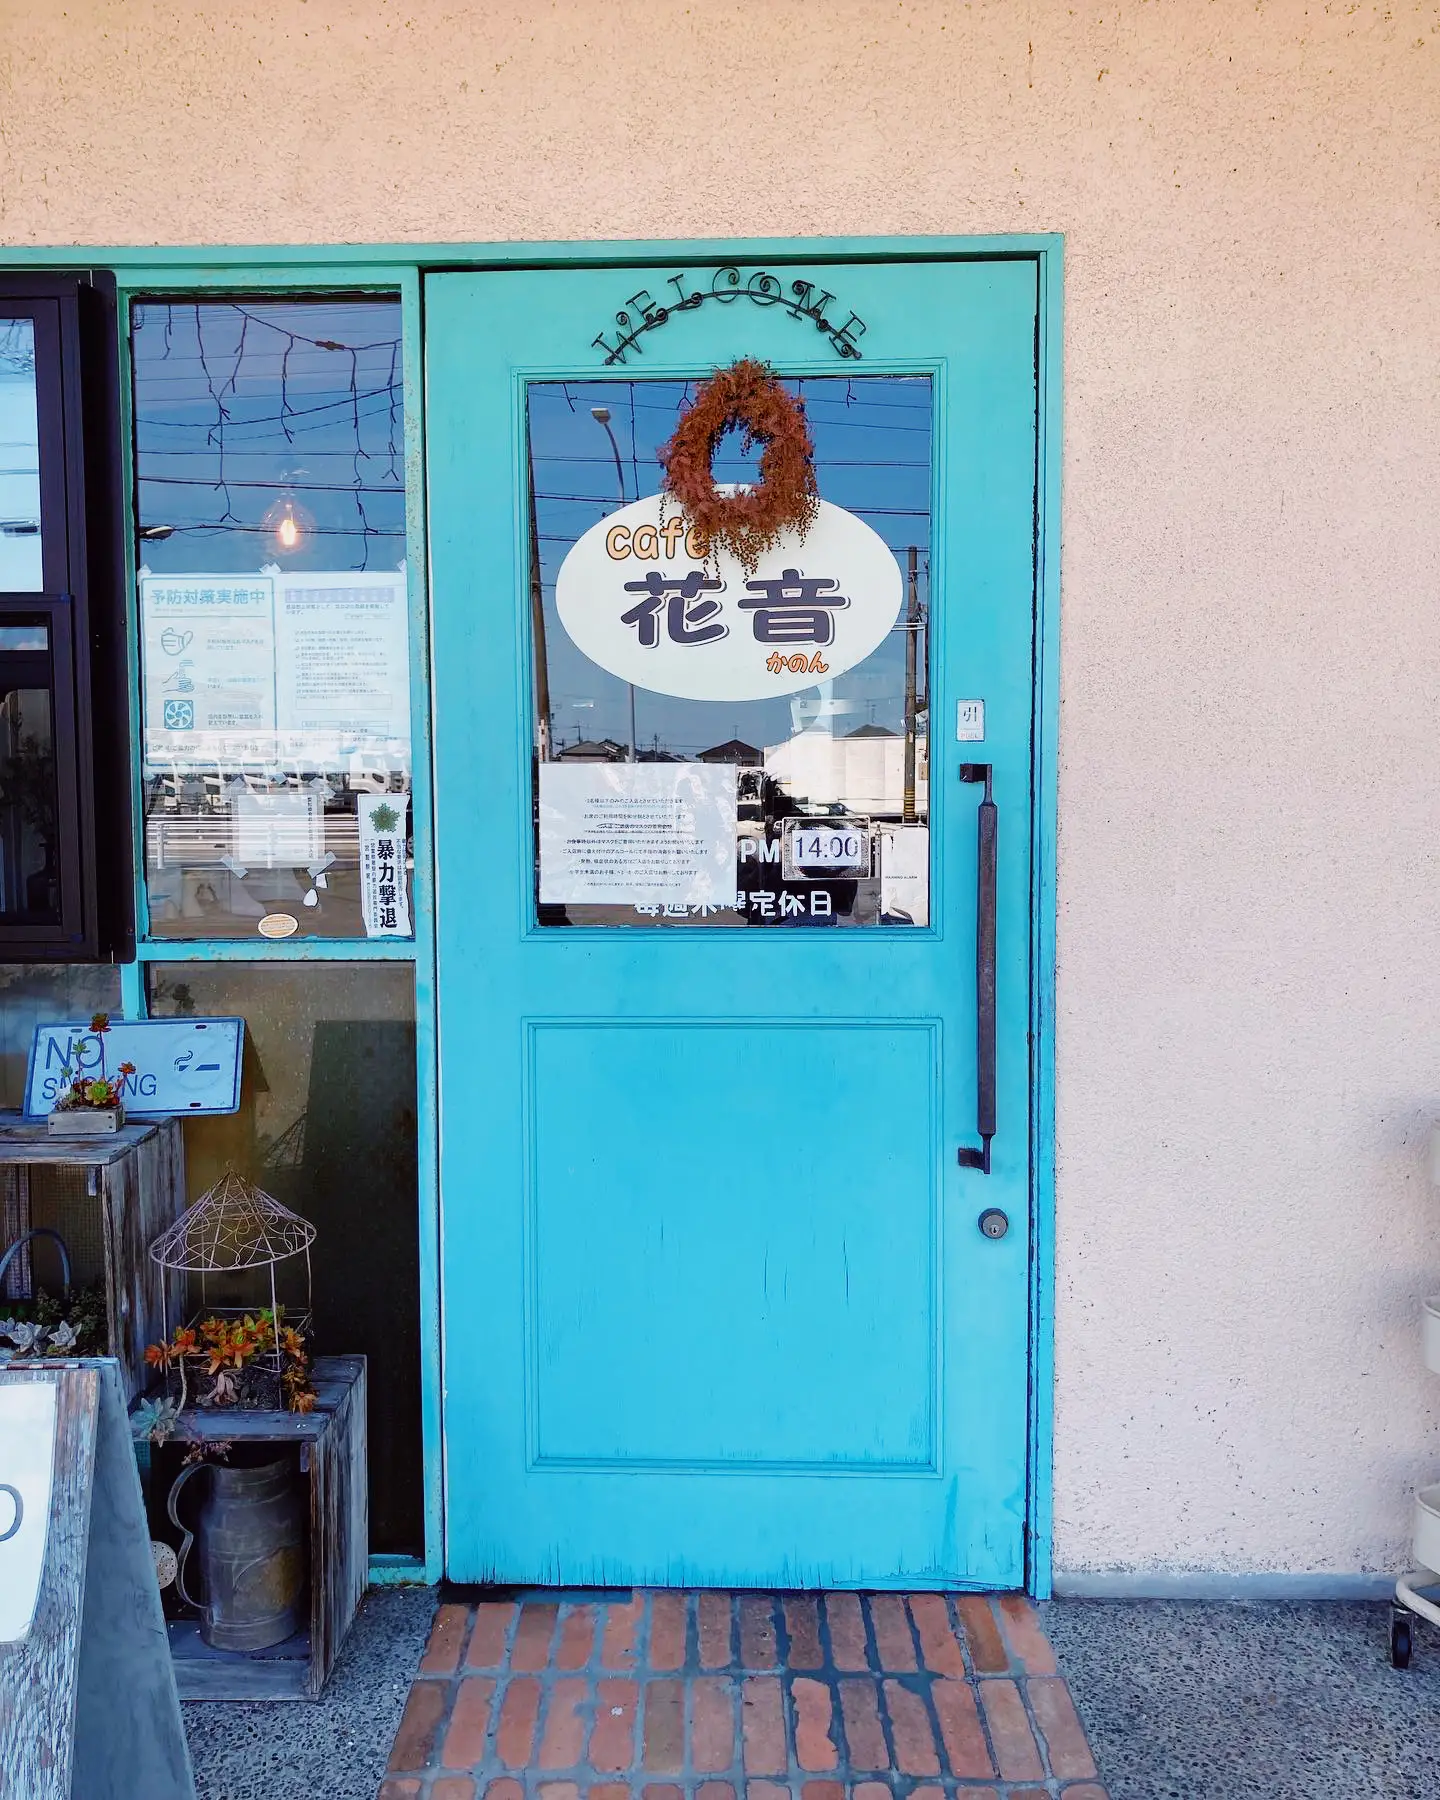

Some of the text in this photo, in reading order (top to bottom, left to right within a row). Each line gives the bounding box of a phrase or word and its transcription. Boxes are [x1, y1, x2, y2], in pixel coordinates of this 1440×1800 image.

[591, 266, 867, 364] WELCOME
[150, 588, 266, 605] 予防対策実施中
[620, 569, 850, 648] 花音
[766, 651, 829, 674] かのん
[740, 839, 780, 863] PM
[795, 836, 859, 859] 14:00
[377, 839, 398, 929] 暴力撃退
[45, 1035, 104, 1070] NO
